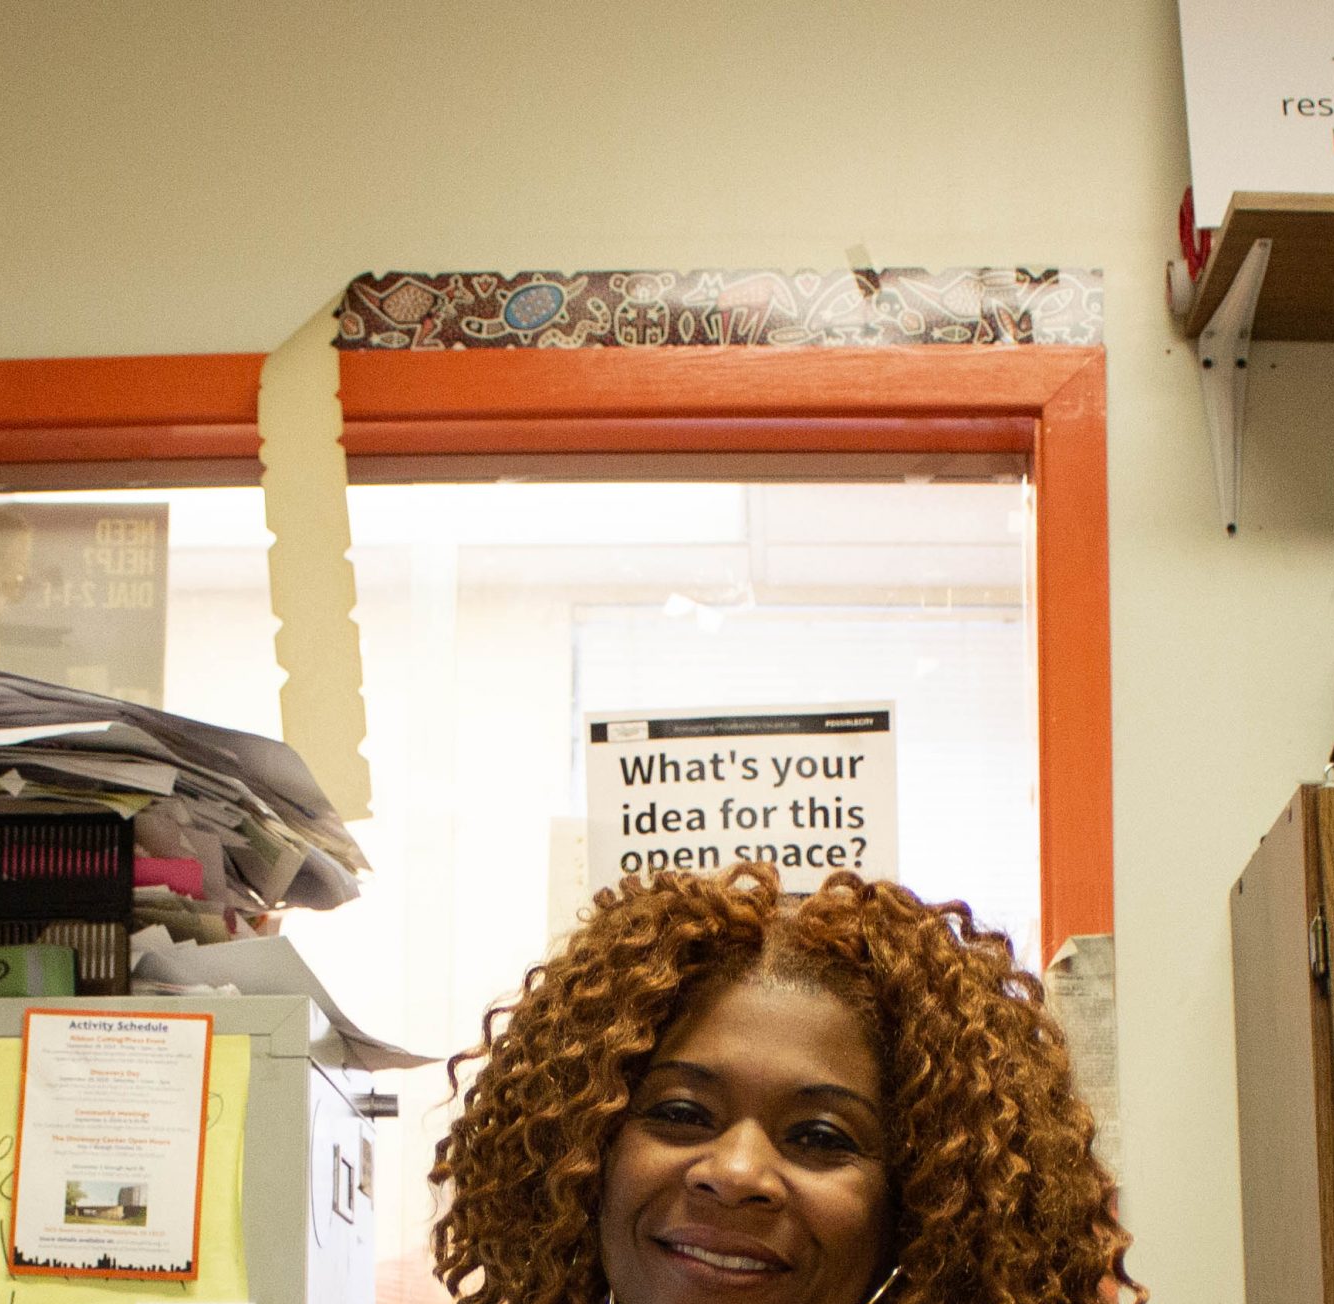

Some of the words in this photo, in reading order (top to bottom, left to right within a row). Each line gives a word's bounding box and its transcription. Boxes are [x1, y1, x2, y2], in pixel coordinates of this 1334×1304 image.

[619, 749, 759, 786] What's
[771, 753, 865, 788] your
[622, 802, 706, 836] idea
[720, 798, 777, 830] for
[790, 796, 865, 829] this
[620, 843, 720, 875] open
[735, 836, 867, 868] space?
[69, 1020, 114, 1032] Activity
[116, 1021, 169, 1033] Schedule
